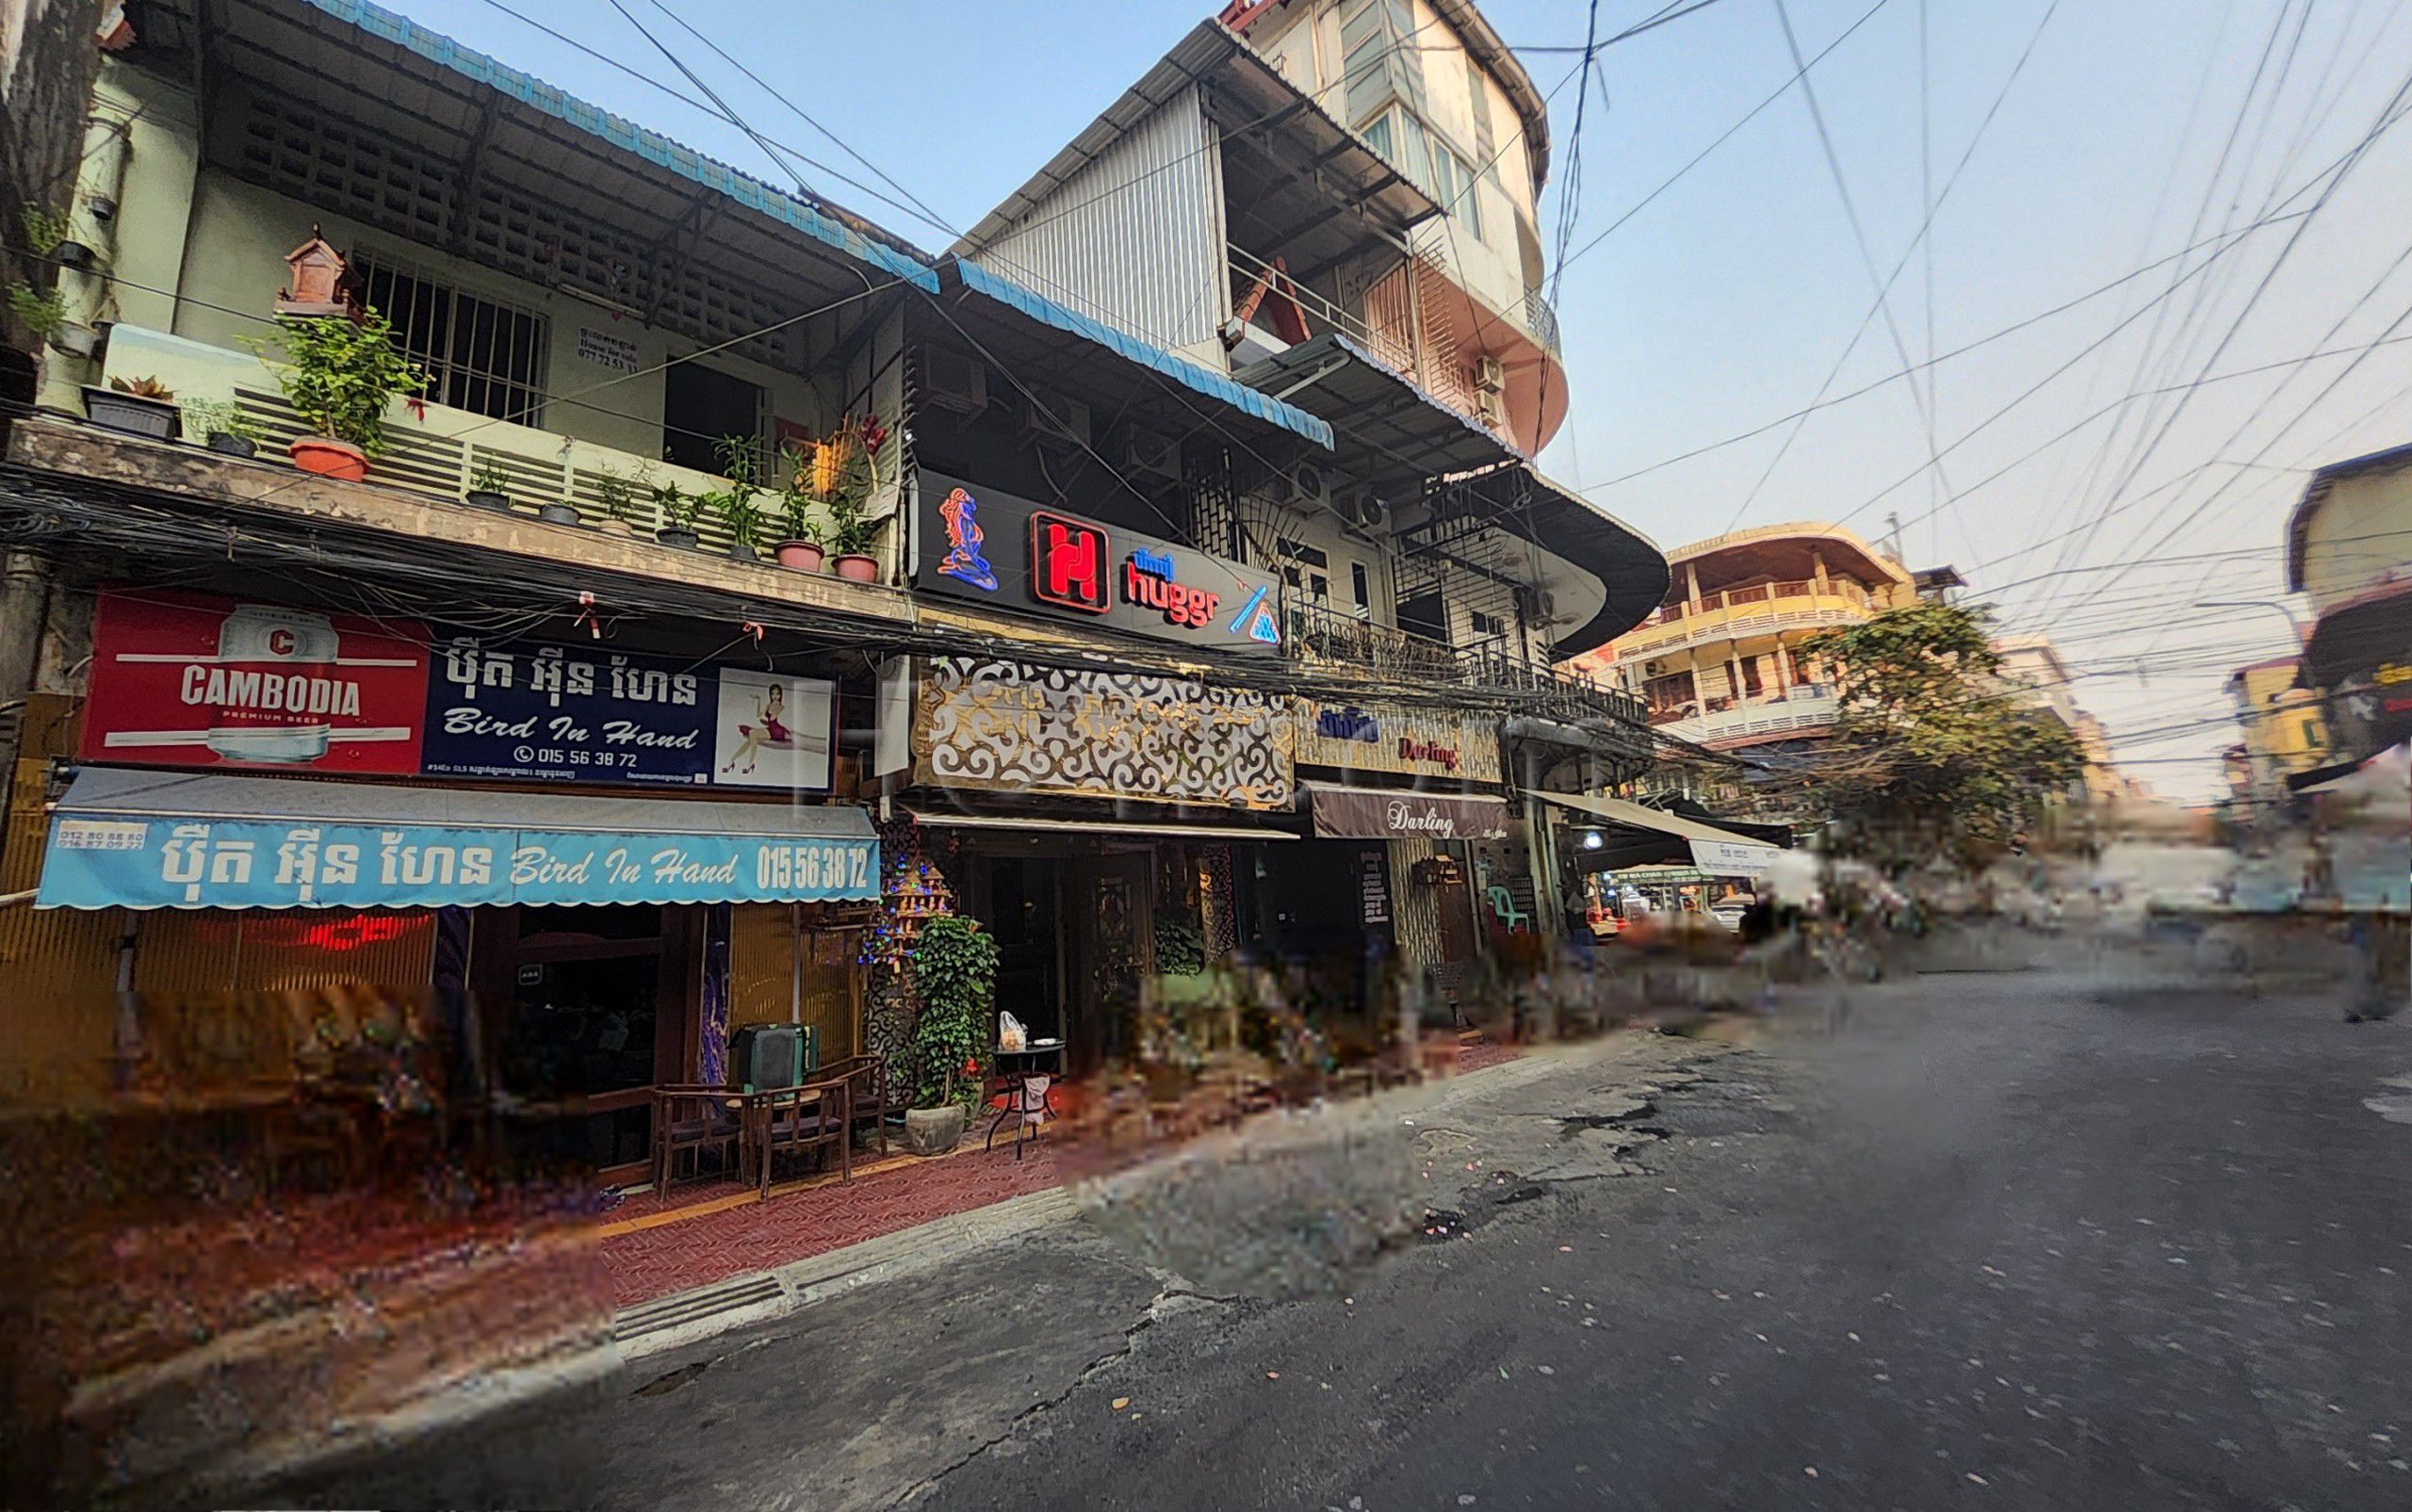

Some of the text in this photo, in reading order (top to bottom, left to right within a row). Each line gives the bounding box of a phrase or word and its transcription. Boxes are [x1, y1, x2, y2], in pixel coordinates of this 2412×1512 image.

[1127, 561, 1220, 627] huggr
[181, 665, 360, 716] CAMBODIA
[222, 711, 282, 722] PREMIUM
[444, 707, 699, 749] Bird In Hand
[538, 749, 637, 767] 015 56 38 72
[1399, 738, 1458, 771] Darling
[1386, 801, 1455, 838] Darling
[509, 846, 867, 888] Bird In Hand 015 56 38 72
